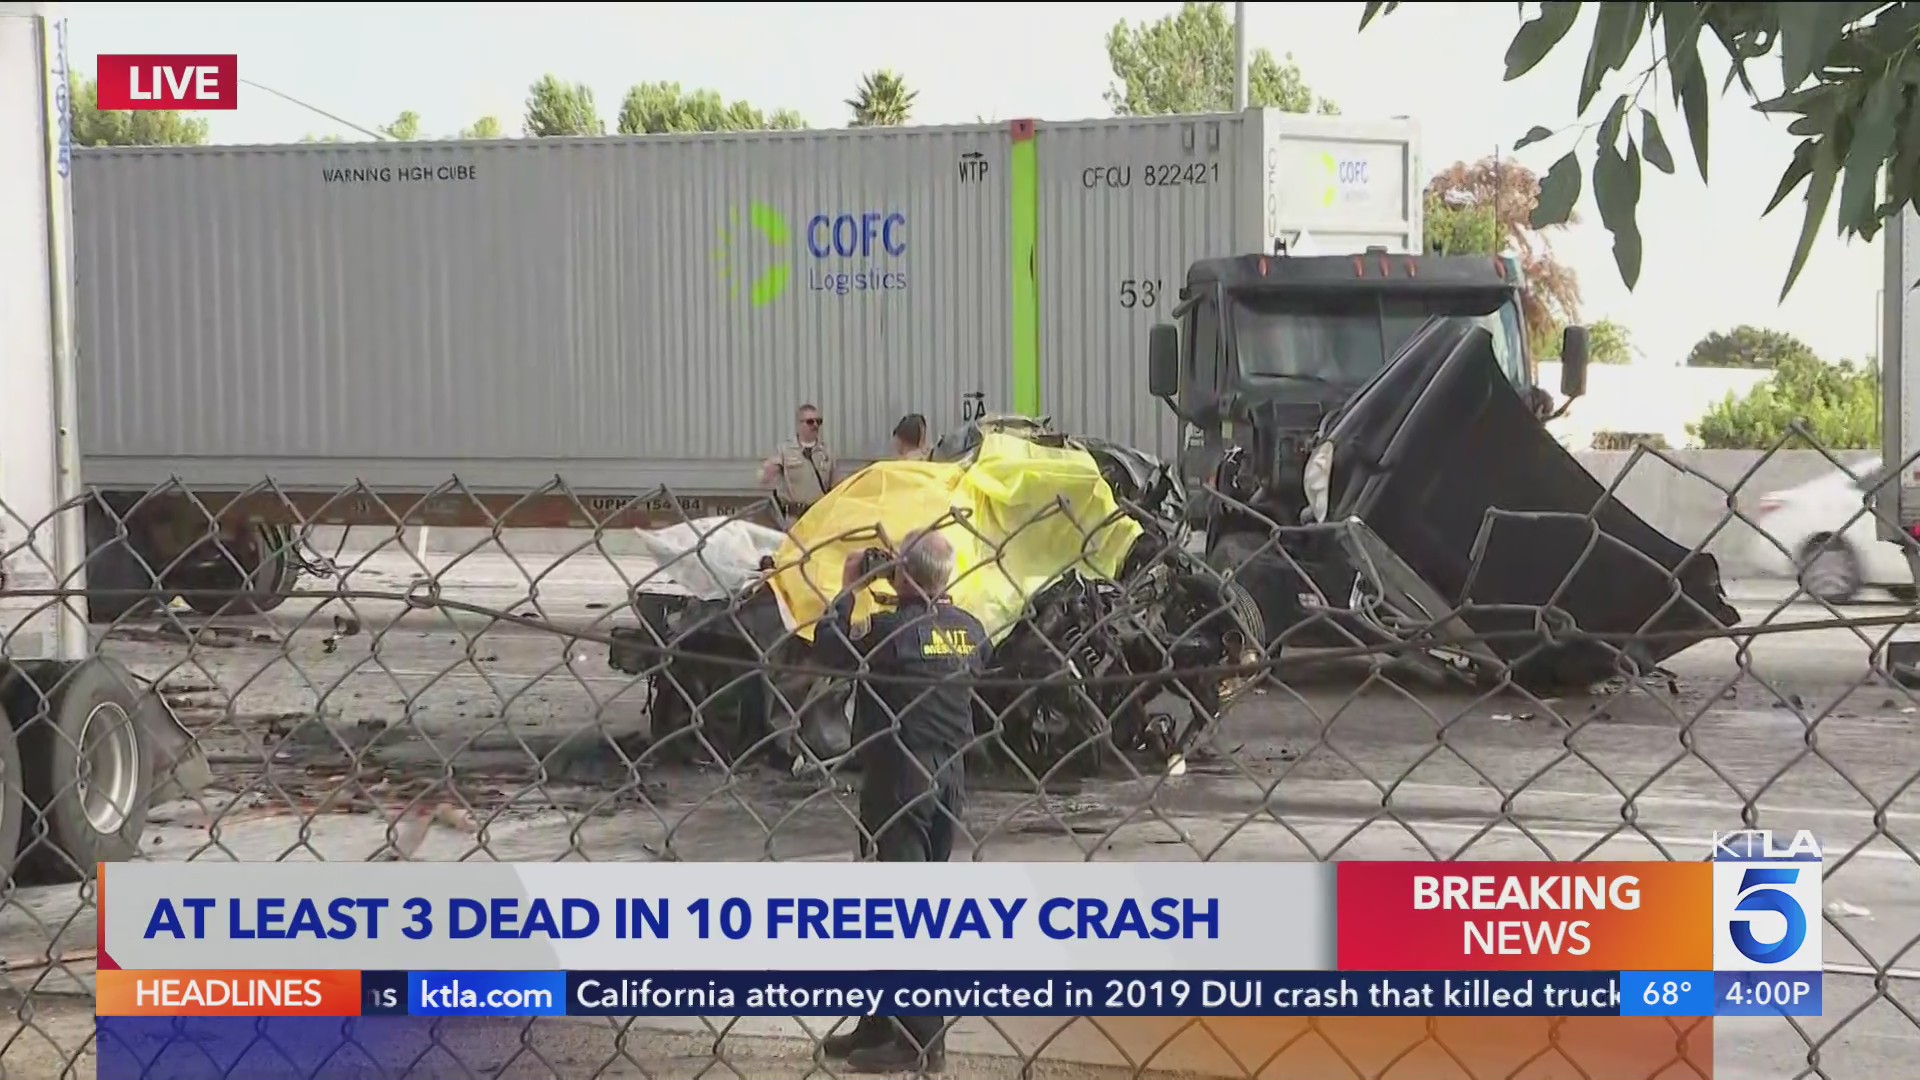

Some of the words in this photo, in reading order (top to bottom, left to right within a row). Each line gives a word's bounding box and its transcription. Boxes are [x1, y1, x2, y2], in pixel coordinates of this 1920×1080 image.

[322, 167, 392, 183] WARNING
[436, 165, 477, 181] CUBE
[958, 160, 989, 184] WTP
[1082, 165, 1131, 188] CFQU
[1144, 162, 1219, 187] 822421
[1338, 160, 1369, 184] COFC
[807, 212, 906, 259] COFC
[809, 266, 907, 296] Logistics
[1119, 279, 1162, 309] 53'
[646, 498, 700, 511] 15484
